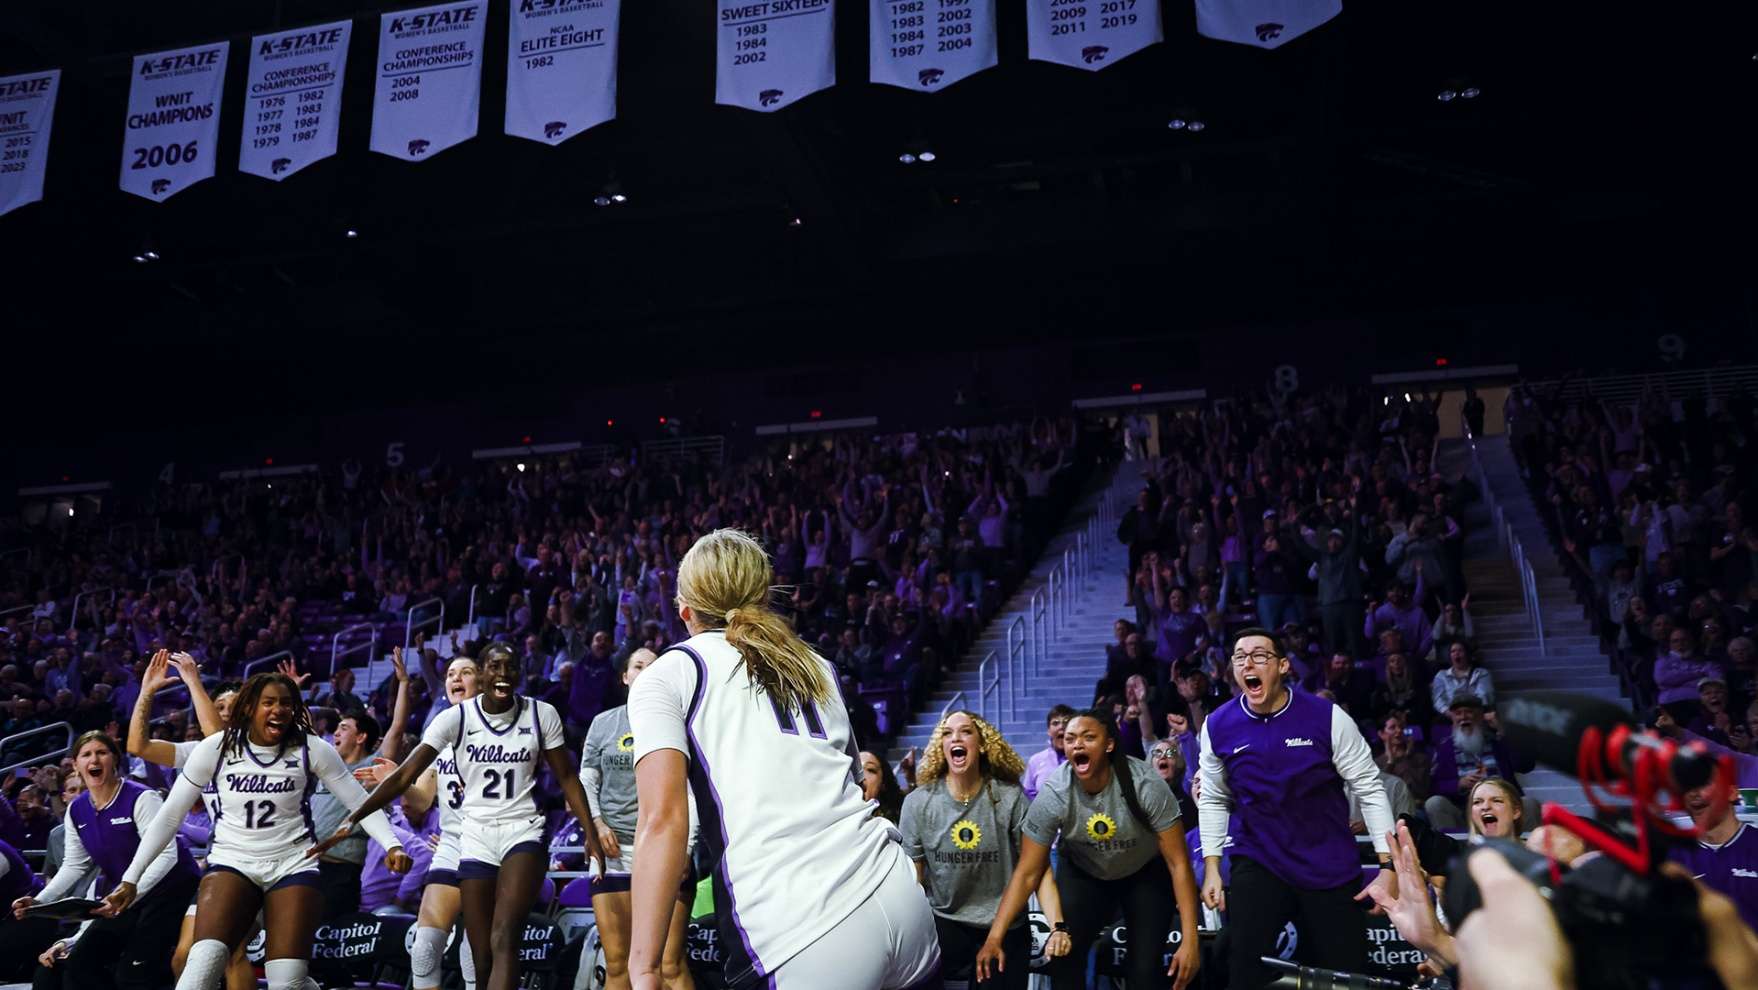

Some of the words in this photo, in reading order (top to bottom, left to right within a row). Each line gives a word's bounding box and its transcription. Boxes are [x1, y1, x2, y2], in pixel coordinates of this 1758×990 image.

[560, 2, 604, 14] BASKETBALL
[721, 3, 770, 21] SWEET
[891, 2, 924, 15] 1982
[1100, 0, 1137, 14] 2017
[389, 6, 479, 34] K-STATE
[891, 16, 924, 29] 1983
[937, 8, 972, 23] 2002
[1051, 6, 1087, 21] 2009
[1101, 14, 1138, 29] 2019
[428, 23, 470, 34] BASKETBALL
[550, 24, 574, 34] NCAA
[736, 23, 767, 37] 1983
[891, 30, 924, 43] 1984
[937, 23, 972, 38] 2003
[1051, 21, 1086, 36] 2011
[259, 27, 343, 56] K-STATE
[521, 36, 557, 52] ELITE
[560, 28, 605, 46] EIGHT
[736, 38, 767, 51] 1984
[891, 44, 925, 58] 1987
[937, 37, 972, 52] 2004
[396, 41, 466, 60] CONFERENCE
[733, 51, 767, 66] 2002
[140, 49, 221, 75] K-STATE
[383, 50, 474, 72] CHAMPIONSHIPS
[526, 56, 554, 70] 1982
[264, 62, 329, 82] CONFERENCE
[251, 71, 336, 93] CHAMPIONSHIPS
[392, 76, 420, 88] 2004
[155, 91, 194, 108] WNIT
[260, 97, 286, 109] 1976
[299, 90, 324, 102] 1982
[390, 89, 419, 102] 2008
[127, 102, 214, 129] CHAMPIONS
[258, 110, 284, 122] 1977
[296, 103, 322, 116] 1983
[256, 123, 282, 135] 1978
[294, 117, 320, 129] 1984
[6, 137, 31, 148] 2015
[253, 137, 280, 149] 1979
[292, 129, 318, 143] 1987
[131, 140, 198, 170] 2006
[1658, 333, 1687, 363] 9
[1275, 364, 1299, 393] 8
[386, 442, 405, 467] 5
[466, 744, 532, 763] Wildcats
[226, 774, 296, 793] Wildcats
[482, 769, 515, 800] 21
[244, 800, 276, 829] 12
[315, 922, 382, 943] Capitol
[523, 924, 554, 941] itol
[311, 937, 376, 960] Federal
